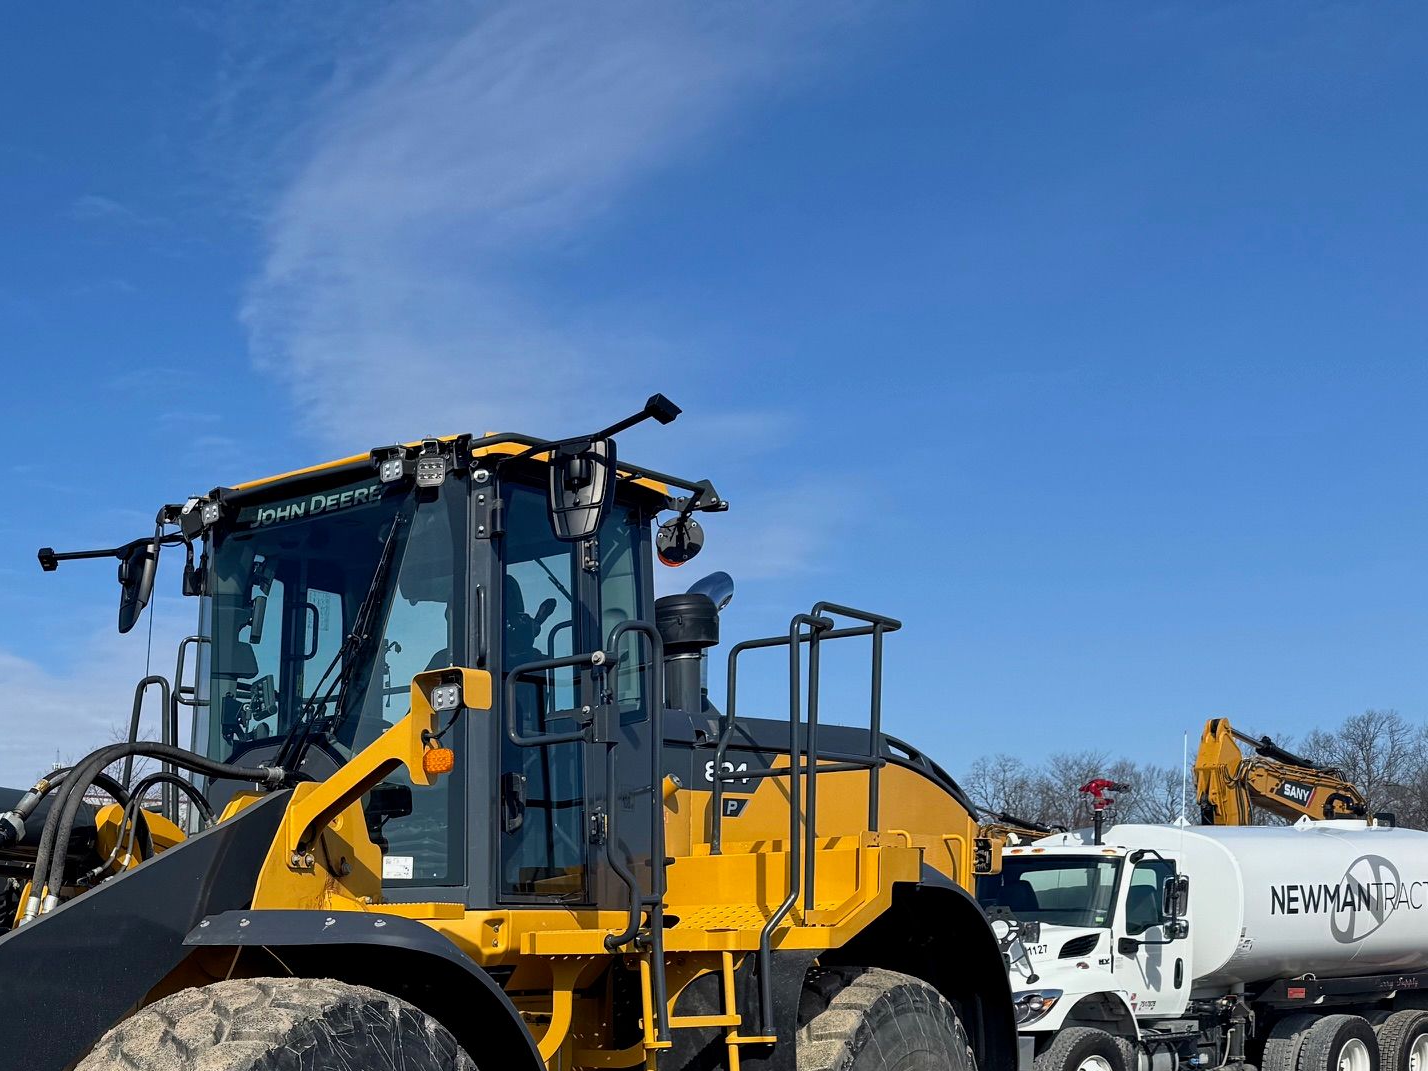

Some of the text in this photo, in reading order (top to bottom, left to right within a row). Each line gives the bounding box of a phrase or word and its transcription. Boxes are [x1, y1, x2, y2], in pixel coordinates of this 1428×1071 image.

[250, 484, 383, 528] JOHN DEERE
[705, 760, 749, 784] 824
[1283, 783, 1310, 801] SANY
[726, 800, 738, 815] P
